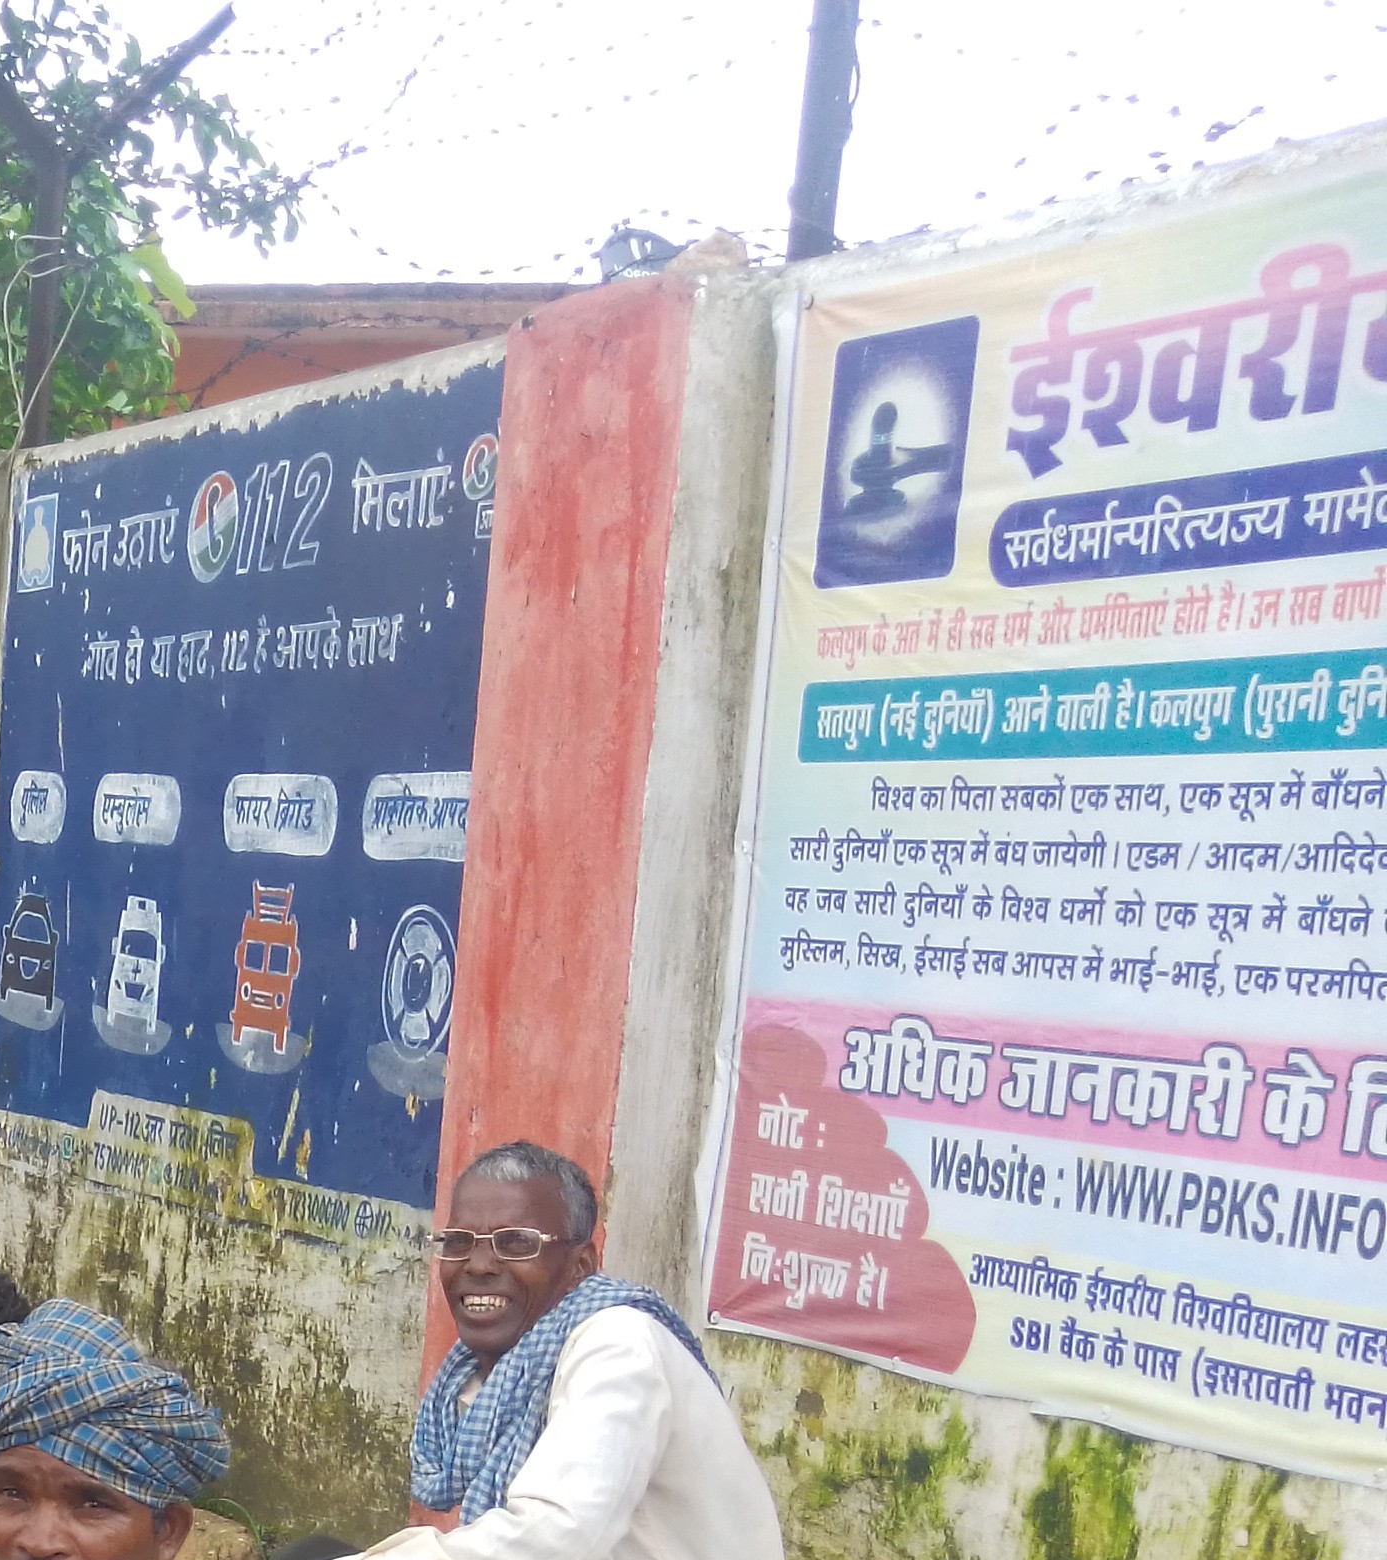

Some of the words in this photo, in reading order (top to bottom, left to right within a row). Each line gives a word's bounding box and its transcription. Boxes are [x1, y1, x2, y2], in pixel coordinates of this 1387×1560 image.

[63, 510, 111, 576] फोन
[236, 452, 333, 575] 112
[151, 635, 175, 677] या
[221, 629, 249, 673] 112
[273, 605, 341, 669] आपके
[348, 613, 404, 667] साथ
[872, 613, 890, 655] के
[947, 606, 966, 652] ही
[1038, 595, 1075, 645] और
[1173, 583, 1213, 635] होते
[817, 703, 875, 750] सतयुग
[1001, 684, 1052, 733] आने
[1057, 682, 1112, 731] वाली
[1150, 686, 1236, 741] कलयुग
[871, 775, 917, 811] विश्व
[920, 786, 946, 810] का
[951, 774, 997, 811] पिता
[1070, 784, 1111, 814] एक
[1114, 783, 1170, 817] साथ,
[1179, 782, 1224, 814] एक
[1229, 781, 1275, 822] सूत्र
[1279, 768, 1306, 810] में
[790, 827, 829, 861] सारी
[831, 827, 893, 872] दुनियाँ
[893, 838, 928, 865] एक
[931, 838, 967, 876] सूत्र
[970, 829, 990, 866] में
[994, 831, 1028, 867] बंध
[1032, 829, 1107, 868] जायेगी
[1127, 842, 1182, 872] एडम
[785, 886, 810, 913] वह
[816, 888, 848, 914] जब
[854, 881, 897, 916] सारी
[903, 882, 968, 928] दुनियाँ
[972, 884, 994, 920] के
[1001, 884, 1051, 923] विश्व
[1115, 888, 1146, 927] को
[1155, 901, 1199, 932] एक
[1207, 902, 1253, 943] सूत्र
[1262, 891, 1287, 933] में
[1297, 894, 1374, 937] बाँधने
[780, 927, 850, 971] मुस्लिम,
[857, 931, 906, 974] सिख,
[914, 934, 970, 980] ईसाई
[972, 948, 1009, 976] सब
[1012, 950, 1078, 981] आपस
[1082, 944, 1104, 982] में
[1234, 964, 1281, 996] एक
[839, 1014, 993, 1105] अधिक
[999, 1041, 1254, 1139] जानकारी
[1262, 1047, 1335, 1145] के
[758, 1092, 808, 1149] नोट
[749, 1170, 808, 1222] सभी
[930, 1135, 1046, 1207] Website
[1075, 1157, 1386, 1260] WWW.PBKS.INFO
[969, 1254, 1082, 1303] आध्यात्मिक
[1085, 1266, 1166, 1321] ईश्वरीय
[1010, 1316, 1051, 1354] SBI
[1103, 1327, 1128, 1369] के
[1134, 1342, 1182, 1382] पास
